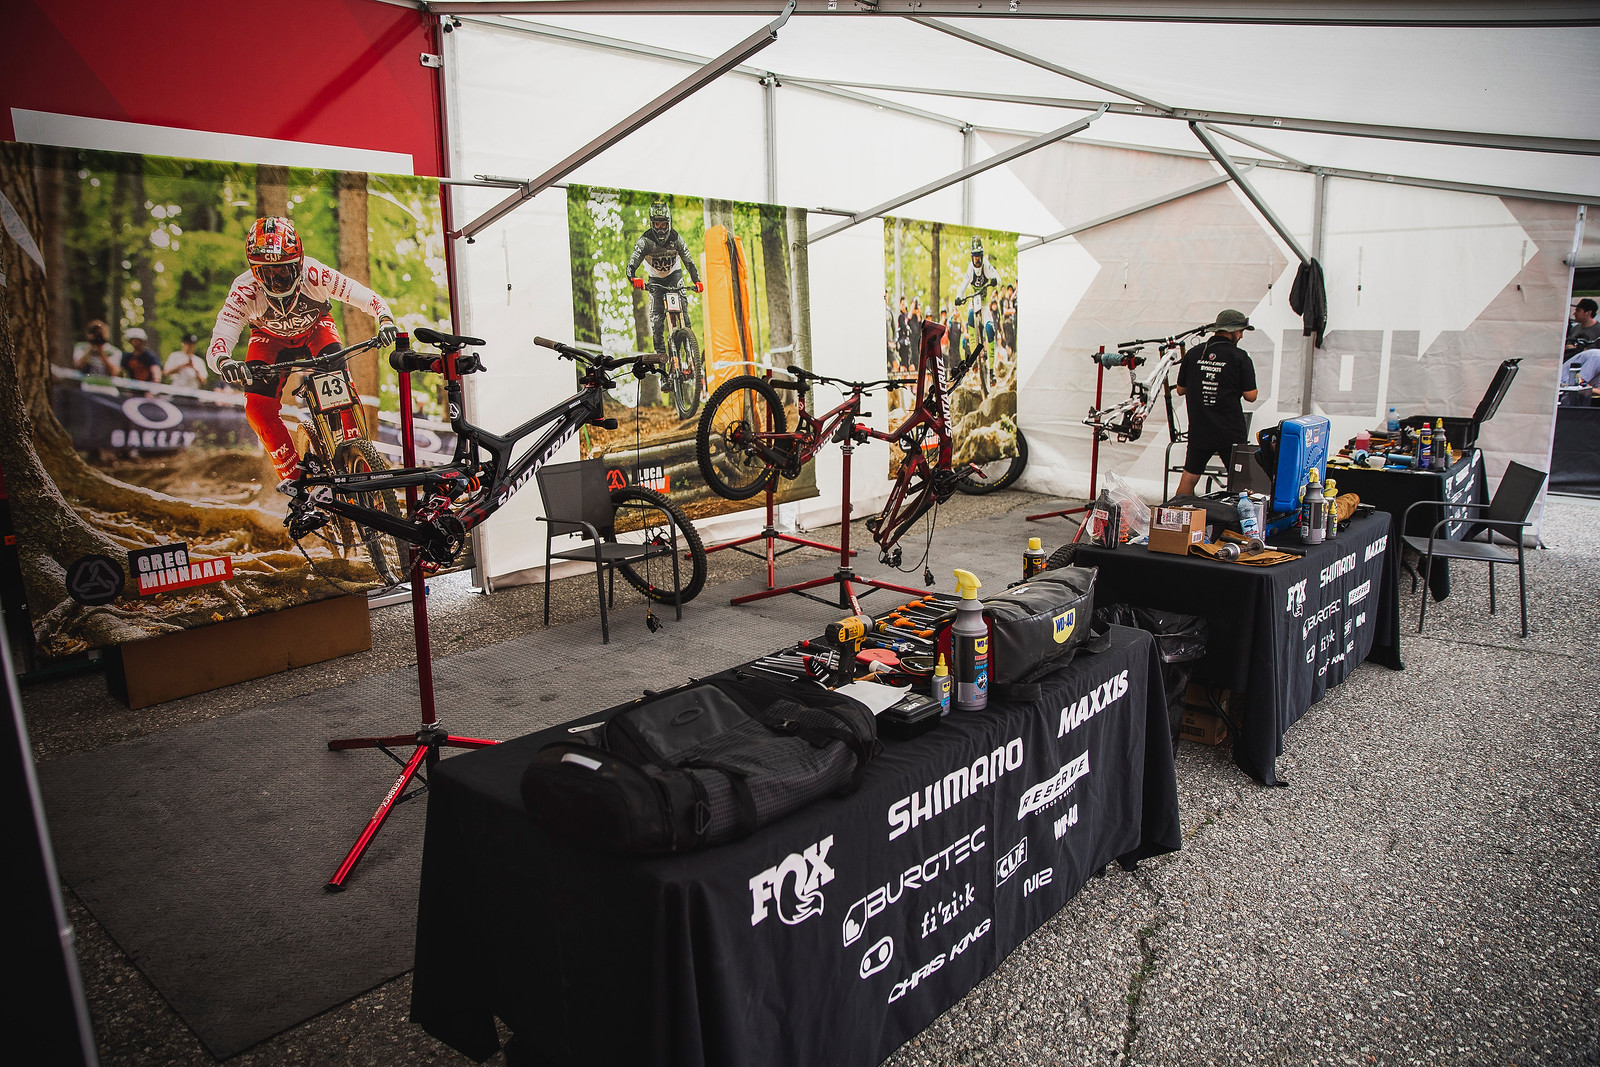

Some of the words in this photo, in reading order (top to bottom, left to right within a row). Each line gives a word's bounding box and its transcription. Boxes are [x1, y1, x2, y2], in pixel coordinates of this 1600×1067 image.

[321, 378, 344, 397] 43
[111, 429, 195, 448] OAKLEY
[637, 466, 662, 481] LUCA
[137, 550, 188, 573] GREG
[1364, 534, 1388, 563] MAXXIS
[140, 559, 227, 590] MINNAAR
[1319, 552, 1357, 588] SHIMANO
[1286, 578, 1308, 617] FOX
[1055, 611, 1074, 634] WD-40
[1057, 669, 1129, 738] MAXXIS
[888, 737, 1024, 841] SHIMANO
[1021, 758, 1086, 811] RESERVE
[866, 824, 986, 919] BURGTEC
[998, 842, 1026, 879] CLIF
[749, 834, 836, 927] FOX
[887, 953, 947, 1005] CHRIS
[949, 917, 992, 961] KING
